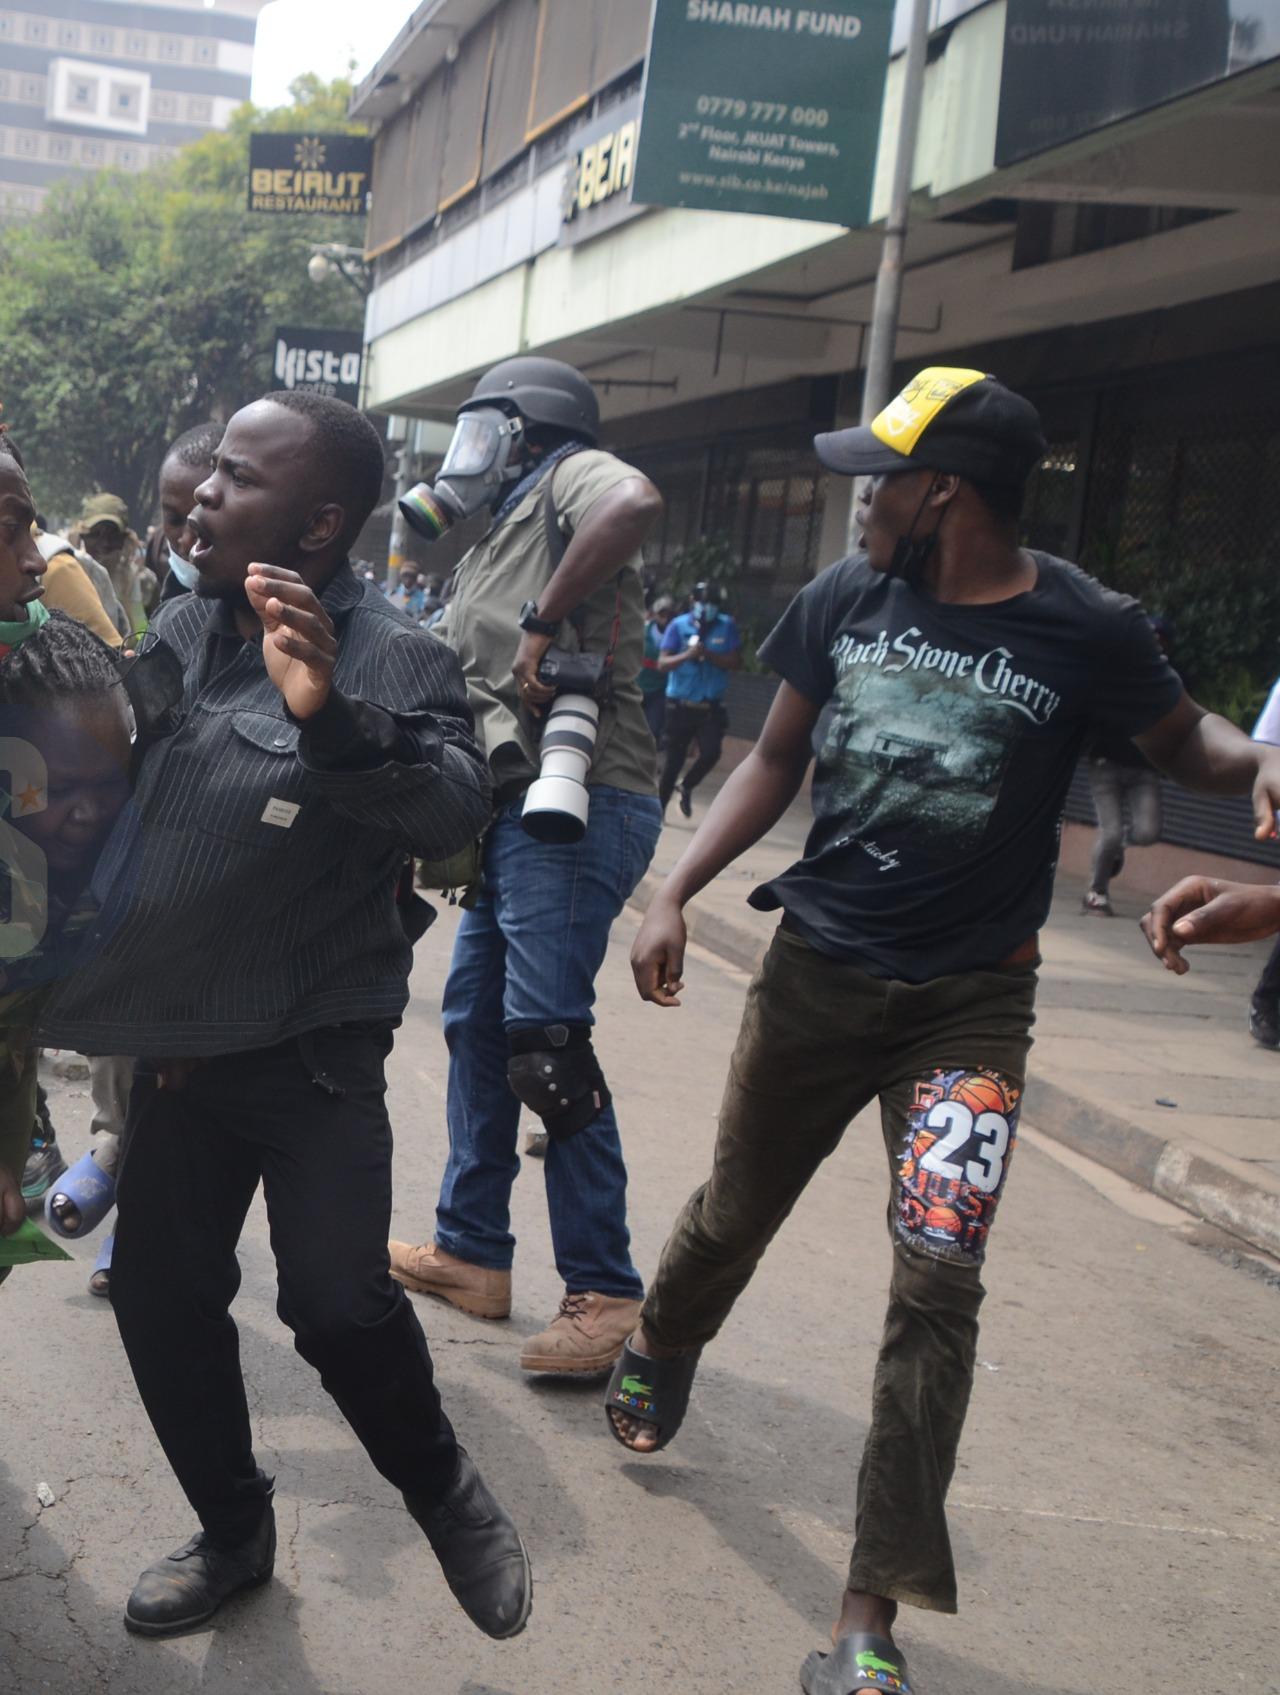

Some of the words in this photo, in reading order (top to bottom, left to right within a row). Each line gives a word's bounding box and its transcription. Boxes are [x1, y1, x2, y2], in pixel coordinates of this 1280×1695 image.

[687, 0, 791, 31] SHARIAH
[795, 10, 862, 39] FUND
[697, 95, 747, 120] 0779
[751, 101, 787, 123] 777
[791, 106, 829, 128] 000
[708, 145, 760, 164] Nairobi
[762, 151, 805, 171] Kenya
[252, 168, 366, 197] BEIRUT
[252, 195, 362, 213] RESTAURANT
[829, 630, 889, 674] Black
[883, 626, 974, 679] Stone
[974, 646, 1062, 725] Cherry
[921, 1100, 1010, 1193] 23
